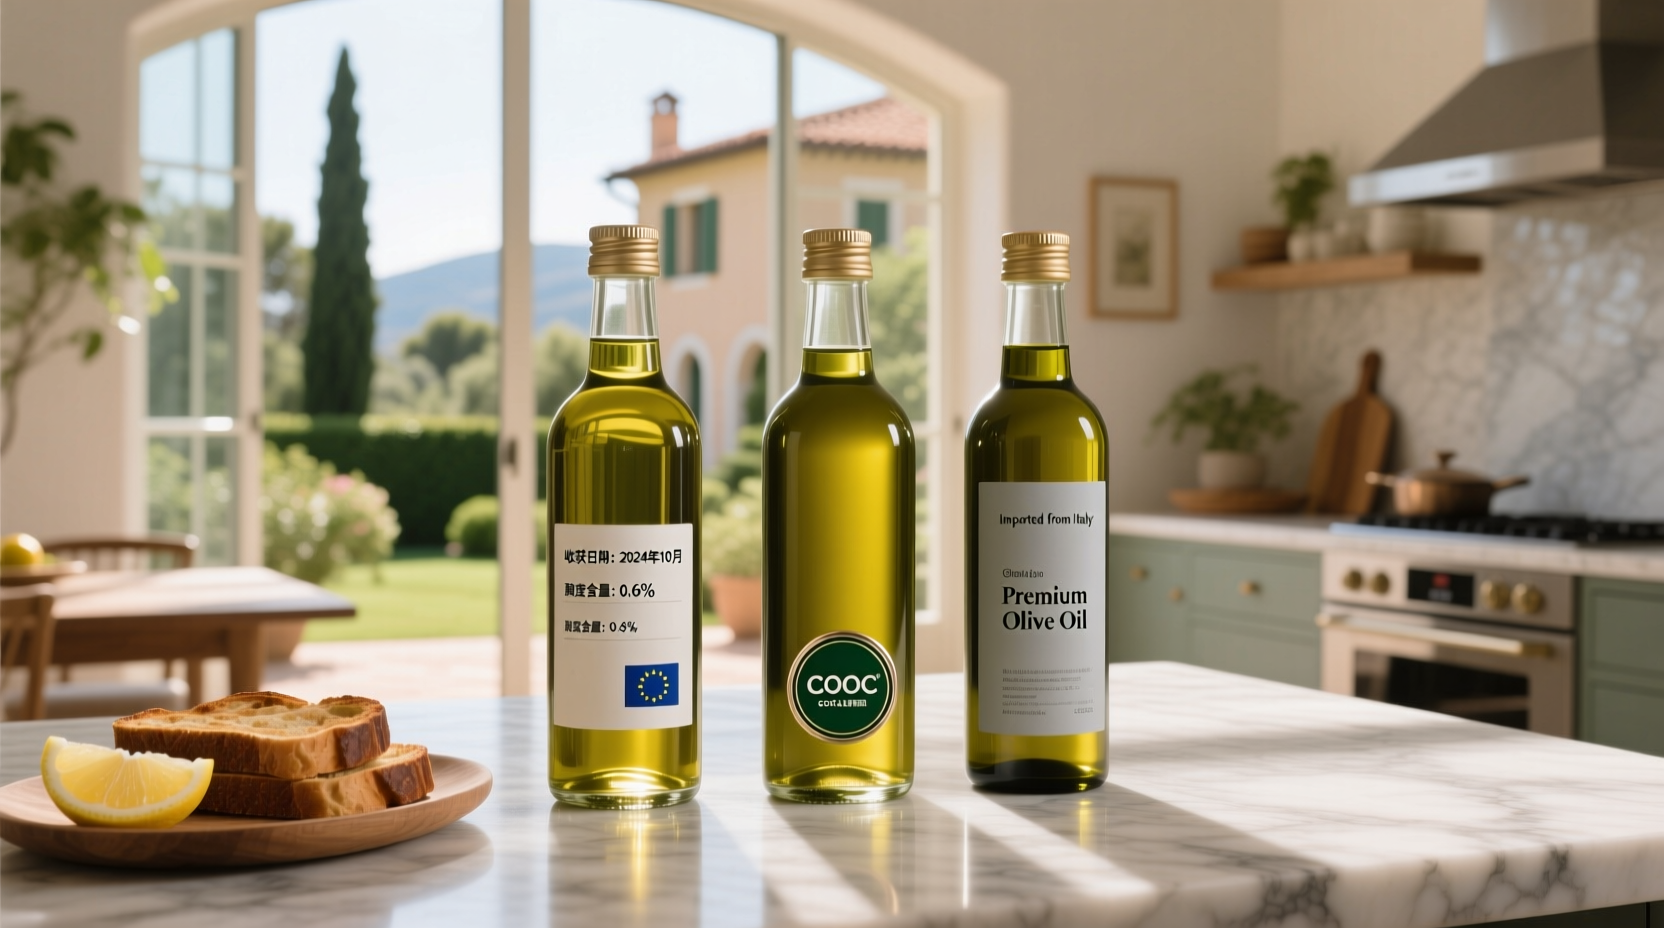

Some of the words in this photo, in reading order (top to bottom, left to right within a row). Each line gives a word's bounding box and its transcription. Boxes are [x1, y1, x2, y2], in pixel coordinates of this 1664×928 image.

[1047, 512, 1071, 525] from
[1073, 512, 1094, 527] Italy
[619, 549, 682, 564] 2024年10月
[619, 583, 655, 598] 0.6%
[1001, 585, 1087, 605] Premium
[1002, 609, 1055, 630] Olive
[1059, 609, 1087, 630] Oil
